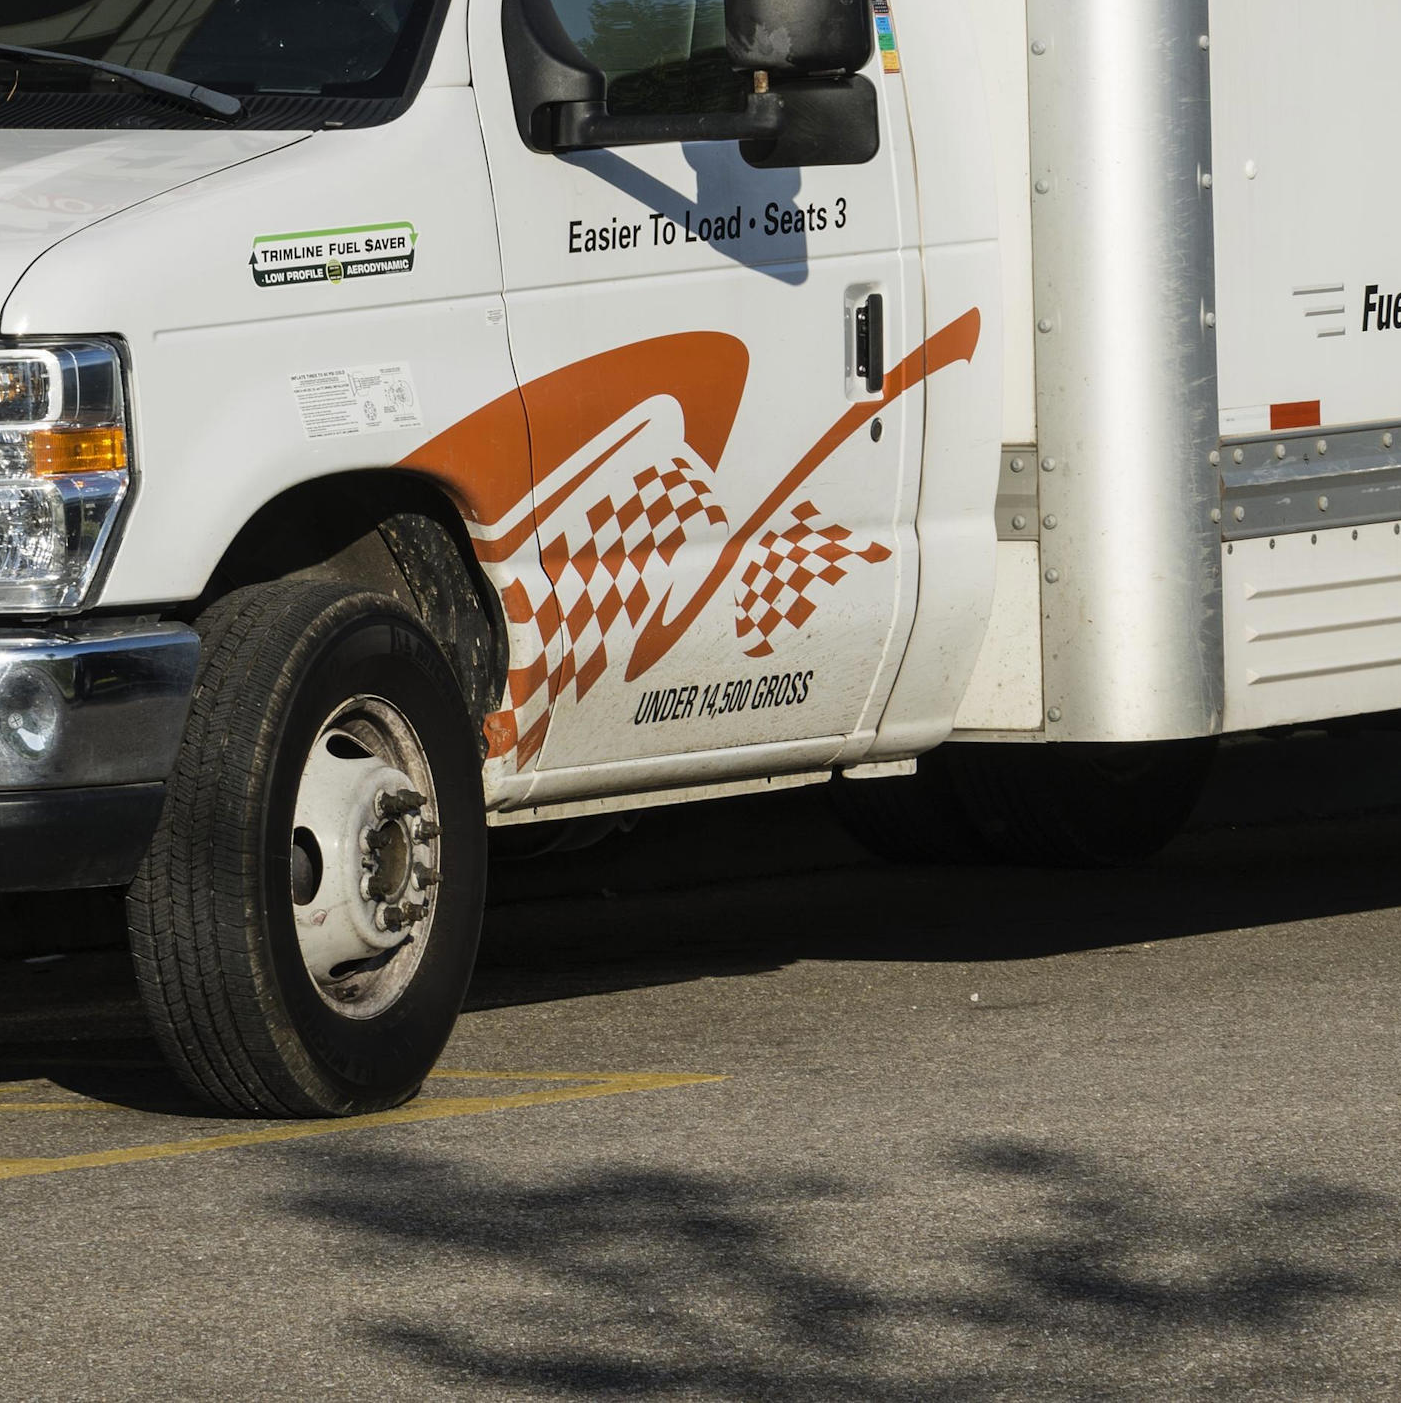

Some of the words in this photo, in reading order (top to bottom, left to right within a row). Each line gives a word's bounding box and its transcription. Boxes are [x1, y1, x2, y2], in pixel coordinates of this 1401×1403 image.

[329, 241, 361, 256] FUEL
[365, 236, 406, 253] $AVER
[568, 217, 641, 255] Easier
[649, 214, 678, 247] To
[684, 207, 742, 243] Load
[763, 202, 828, 237] Seats
[833, 198, 848, 230] 3
[265, 273, 285, 284] LOW
[287, 268, 324, 282] PROFILE
[347, 259, 410, 276] AERODYNAMIC
[634, 685, 700, 726] UNDER
[698, 679, 751, 720] 14,500
[752, 670, 814, 709] GROSS
